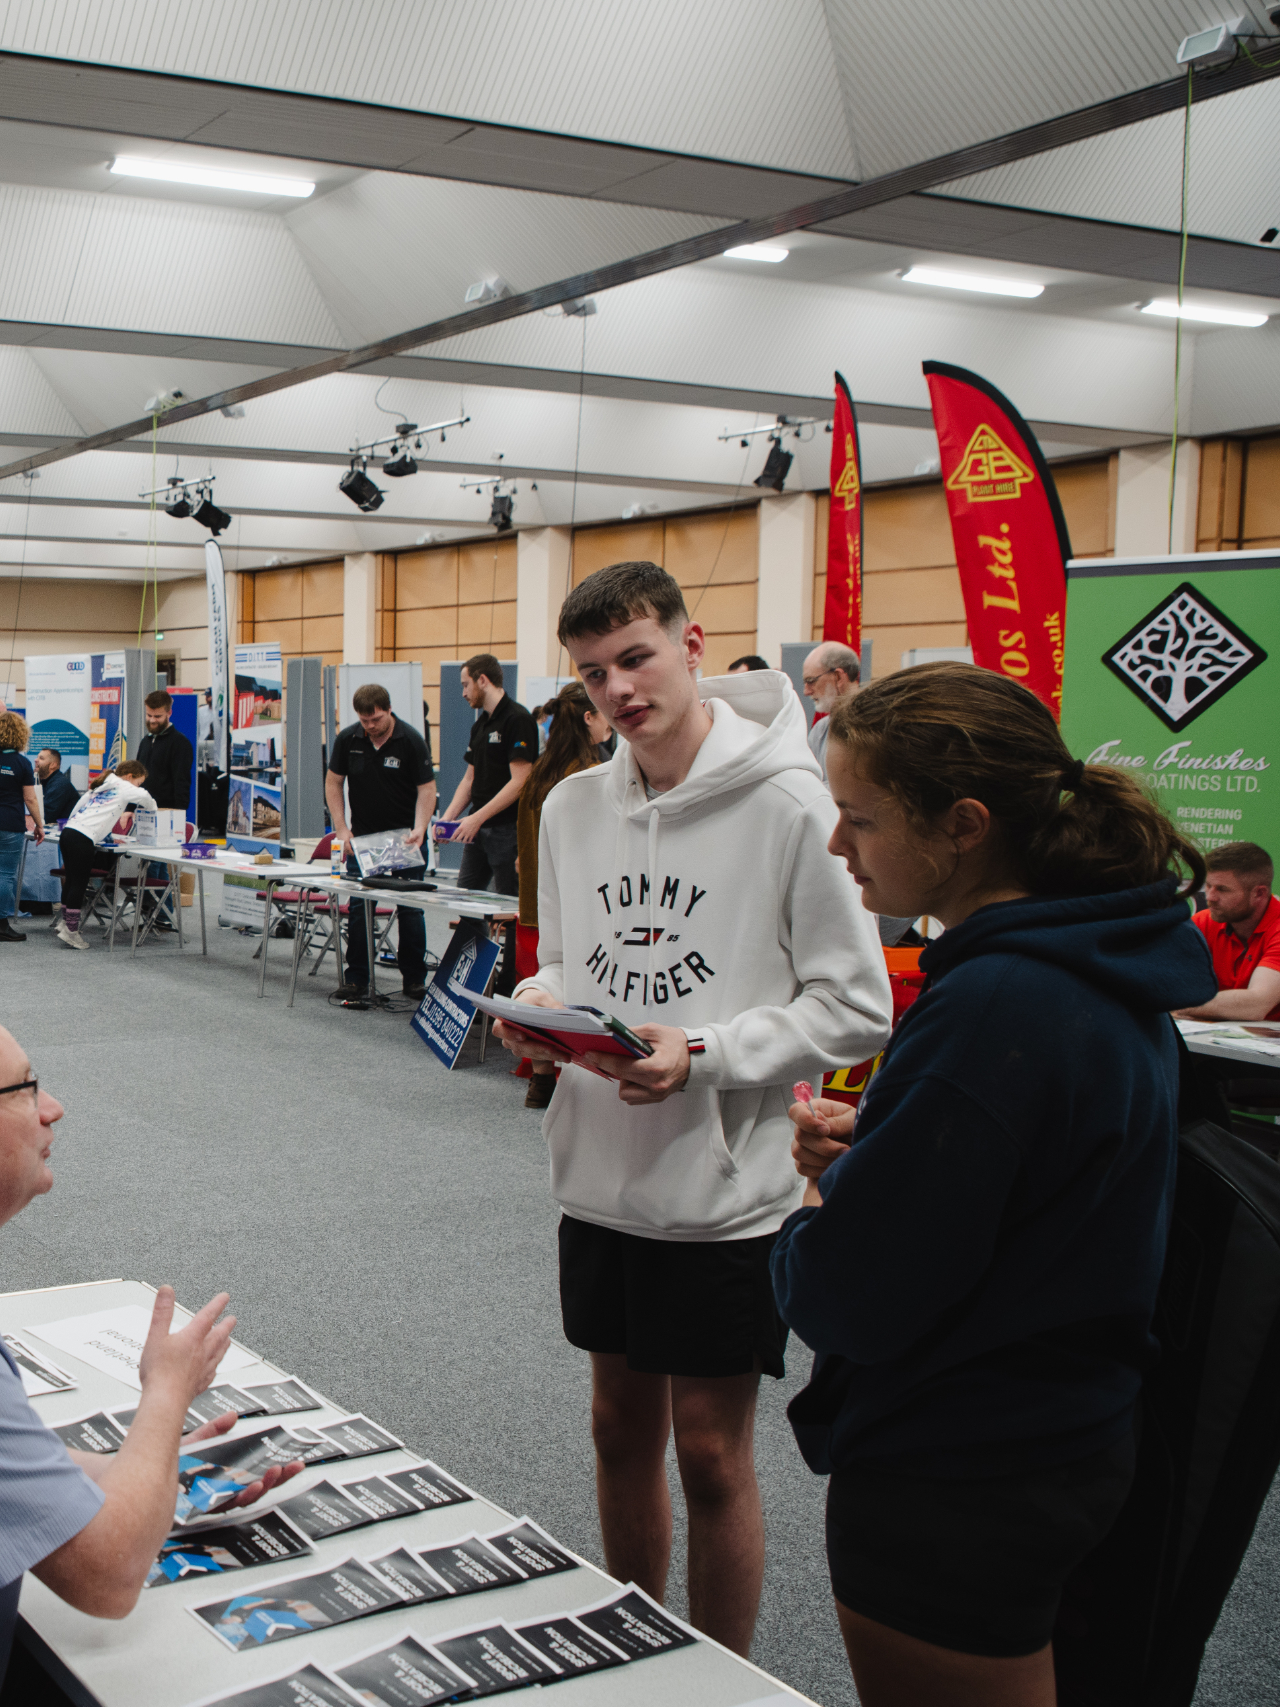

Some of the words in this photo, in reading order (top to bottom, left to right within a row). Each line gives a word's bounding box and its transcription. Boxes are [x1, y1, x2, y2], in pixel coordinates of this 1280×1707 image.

[977, 522, 1021, 614] Ltd.
[1085, 740, 1147, 769] Fine
[1153, 740, 1271, 772] Finishes
[1144, 772, 1221, 793] OATINGS
[1226, 774, 1261, 793] LTD.
[1177, 807, 1243, 821] RENDERING
[597, 873, 707, 918] TOMMY
[585, 943, 716, 1005] HILFIGER
[99, 1328, 144, 1351] ational
[614, 1606, 672, 1645] RECREATION
[628, 1626, 662, 1648] SPORT
[477, 1636, 529, 1678] RECREATION
[543, 1627, 598, 1666] RECREATION
[554, 1646, 586, 1668] SPORT
[487, 1658, 518, 1682] SPORT
